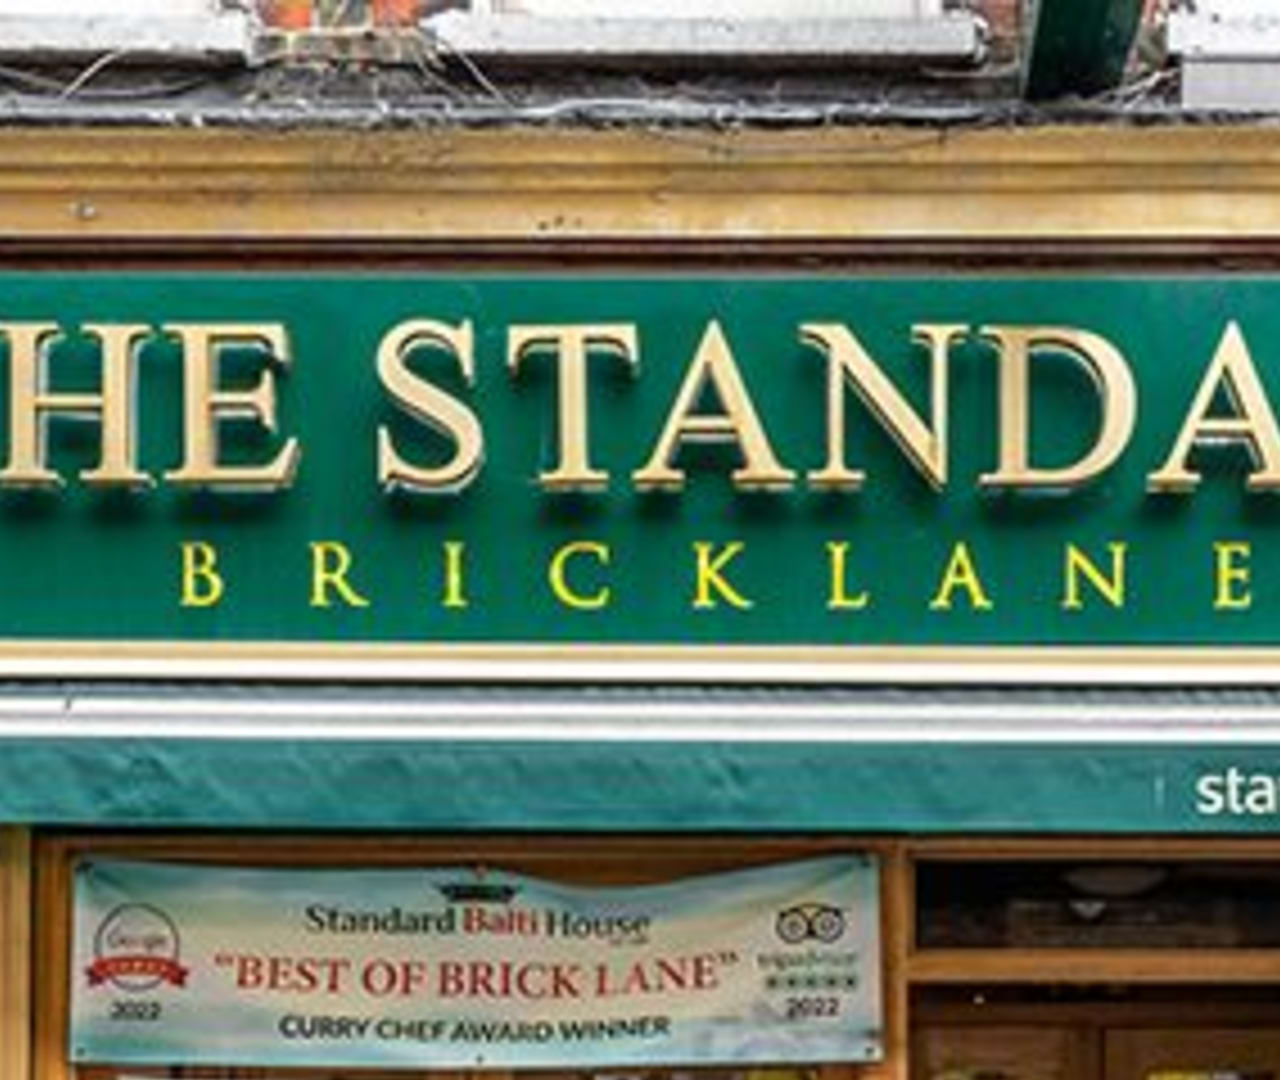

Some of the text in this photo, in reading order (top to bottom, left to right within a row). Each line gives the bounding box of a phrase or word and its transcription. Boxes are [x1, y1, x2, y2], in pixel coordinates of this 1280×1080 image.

[304, 902, 652, 938] Standard Balti House
[361, 962, 424, 997] OF
[439, 960, 582, 999] BRICK
[785, 996, 840, 1020] 2022
[278, 1014, 672, 1043] CURRY CHEF AWARD WINNER
